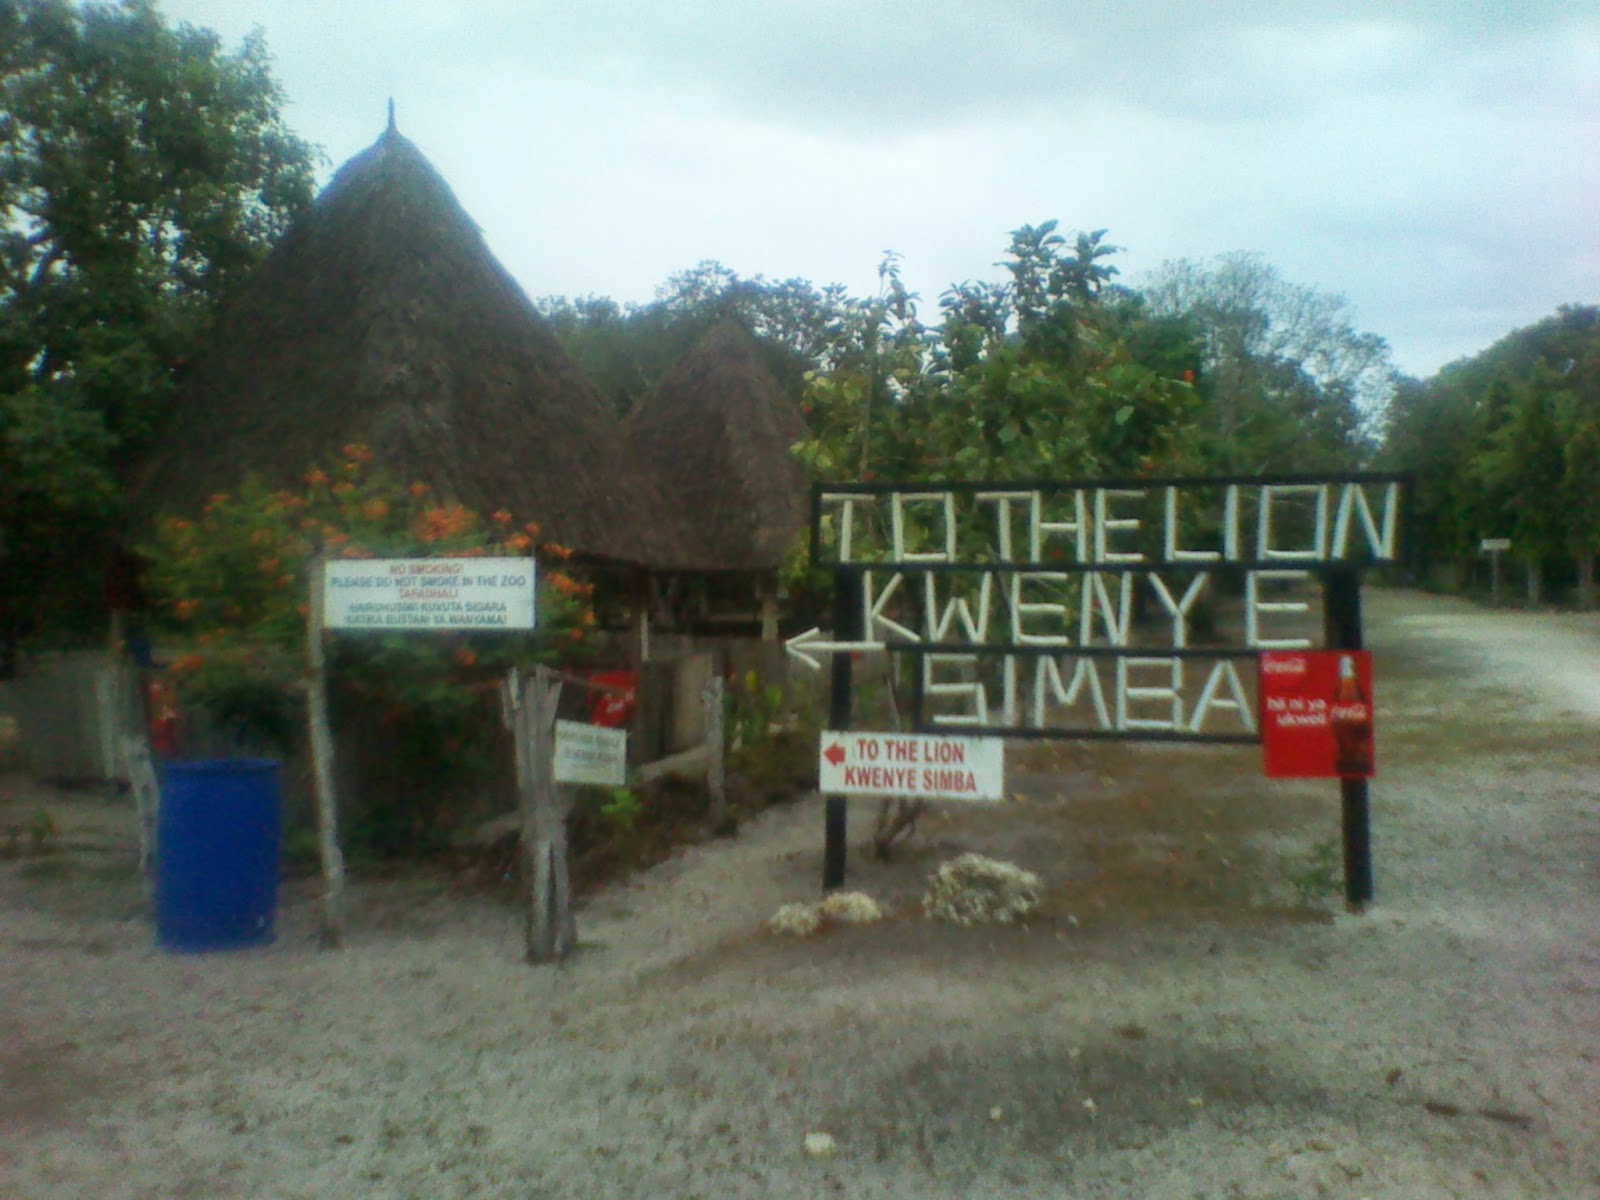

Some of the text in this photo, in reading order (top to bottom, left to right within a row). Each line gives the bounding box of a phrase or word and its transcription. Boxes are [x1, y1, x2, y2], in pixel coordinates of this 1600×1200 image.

[822, 482, 1397, 562] TO THE LION
[330, 575, 526, 588] PLEASE DO NOT SMOKE IN THE ZOO
[390, 563, 406, 575] NO
[924, 653, 1259, 733] SIMBA
[857, 739, 965, 764] TO THE LION
[845, 766, 977, 793] KWENYE SIMBA
